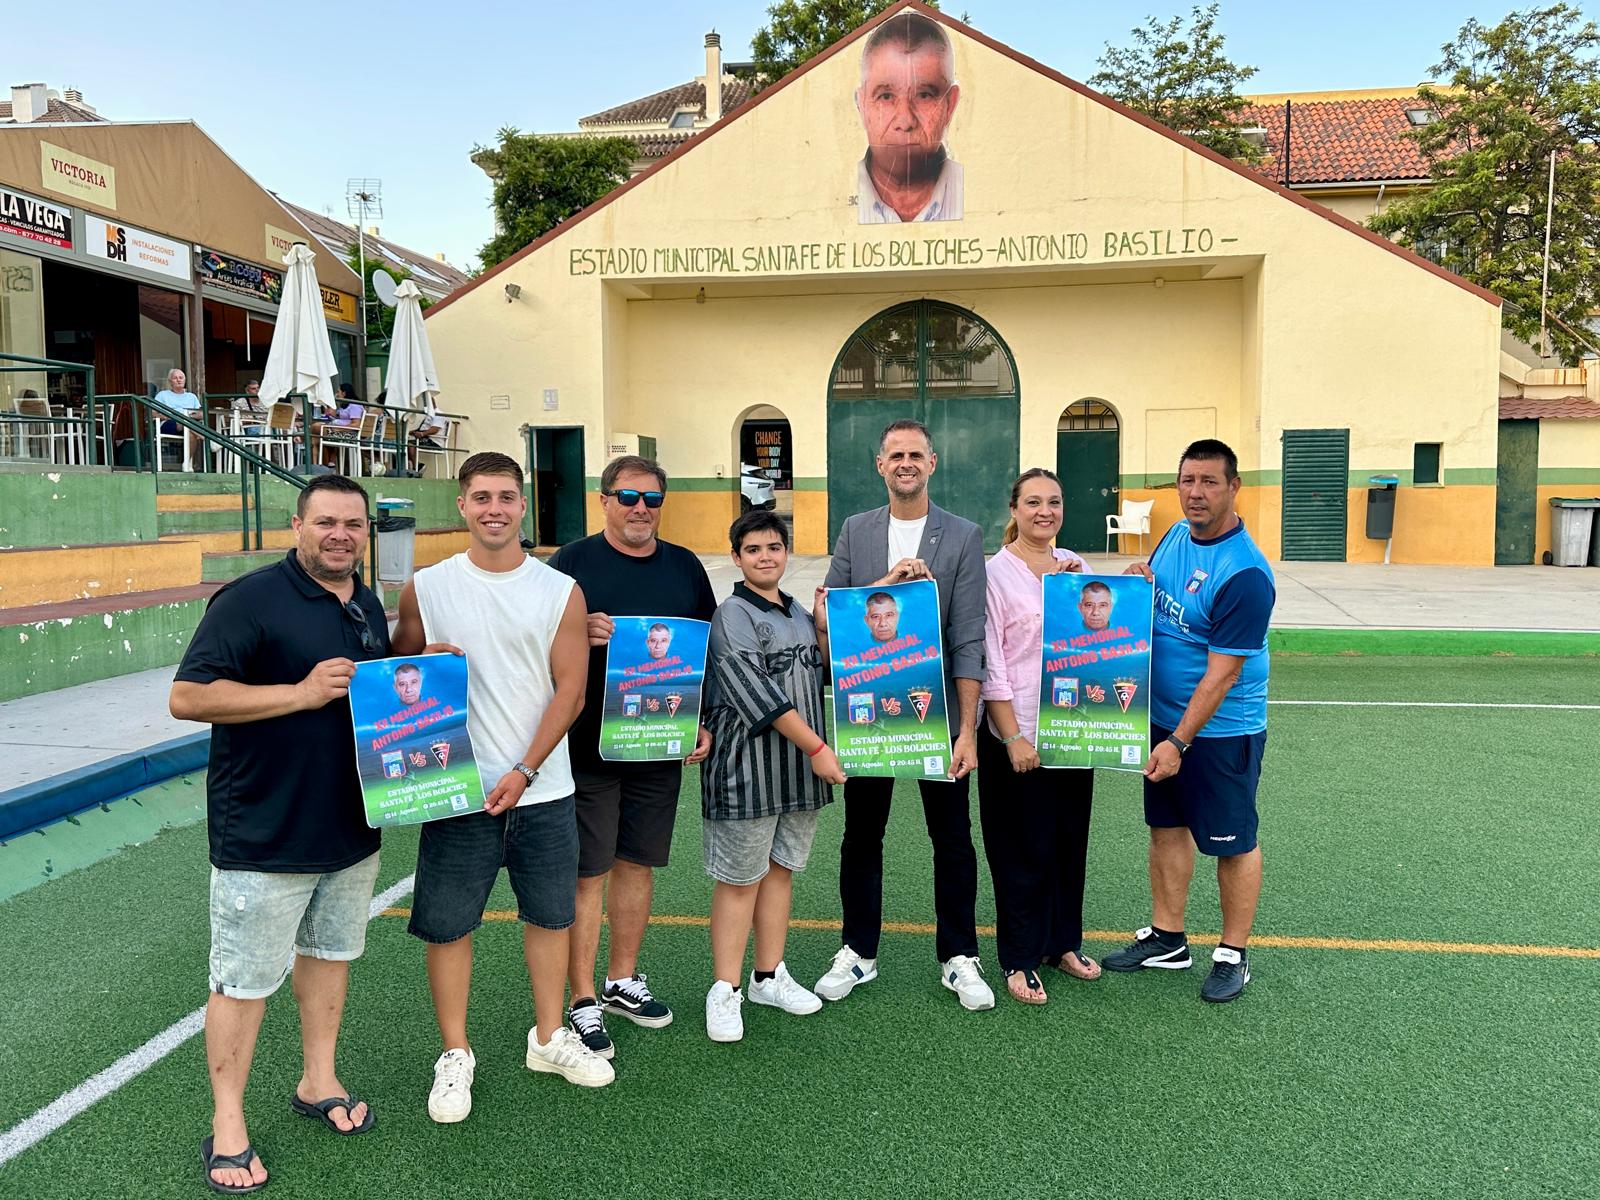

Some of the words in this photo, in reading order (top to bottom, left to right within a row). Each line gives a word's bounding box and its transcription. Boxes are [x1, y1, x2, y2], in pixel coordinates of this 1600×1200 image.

[51, 158, 106, 188] VICTORIA
[0, 193, 20, 219] LA
[24, 200, 65, 231] VEGA
[105, 223, 126, 245] MS
[106, 241, 127, 262] DH
[132, 239, 175, 257] INSTALACIONES
[271, 236, 293, 252] VICTO
[569, 247, 647, 276] ESTADIO
[653, 246, 740, 273] MUNICIPAL
[826, 242, 846, 269] DE
[853, 241, 885, 268] LOS
[888, 237, 983, 267] BOLICHES
[1104, 228, 1213, 258] BASILIO
[139, 252, 169, 266] REFORMAS
[755, 430, 782, 446] CHANGE
[768, 446, 782, 457] BODY
[770, 458, 780, 468] DAY
[1052, 639, 1068, 652] XII
[1069, 626, 1134, 648] MEMORIAL
[840, 655, 858, 670] XII
[860, 632, 922, 665] MEMORIAL
[1046, 651, 1098, 673] ANTONIO
[1100, 639, 1148, 661] BASILIO
[838, 663, 891, 691] ANTONIO
[892, 645, 938, 672] BASILIO
[1051, 719, 1087, 729] ESTADIO
[1088, 720, 1135, 730] MUNICIPAL
[849, 735, 886, 746] ESTADIO
[887, 731, 934, 744] MUNICIPAL
[1040, 729, 1066, 738] SANTA
[1067, 730, 1079, 738] FE
[1084, 730, 1102, 740] LOS
[1103, 731, 1146, 741] BOLICHES
[839, 747, 865, 757] SANTA
[866, 746, 879, 755] FE
[884, 744, 902, 754] LOS
[903, 741, 946, 754] BOLICHES
[1059, 743, 1082, 752] Agosto
[1095, 745, 1113, 753] 20:45
[861, 761, 883, 770] Agosto
[897, 758, 915, 766] 20:45
